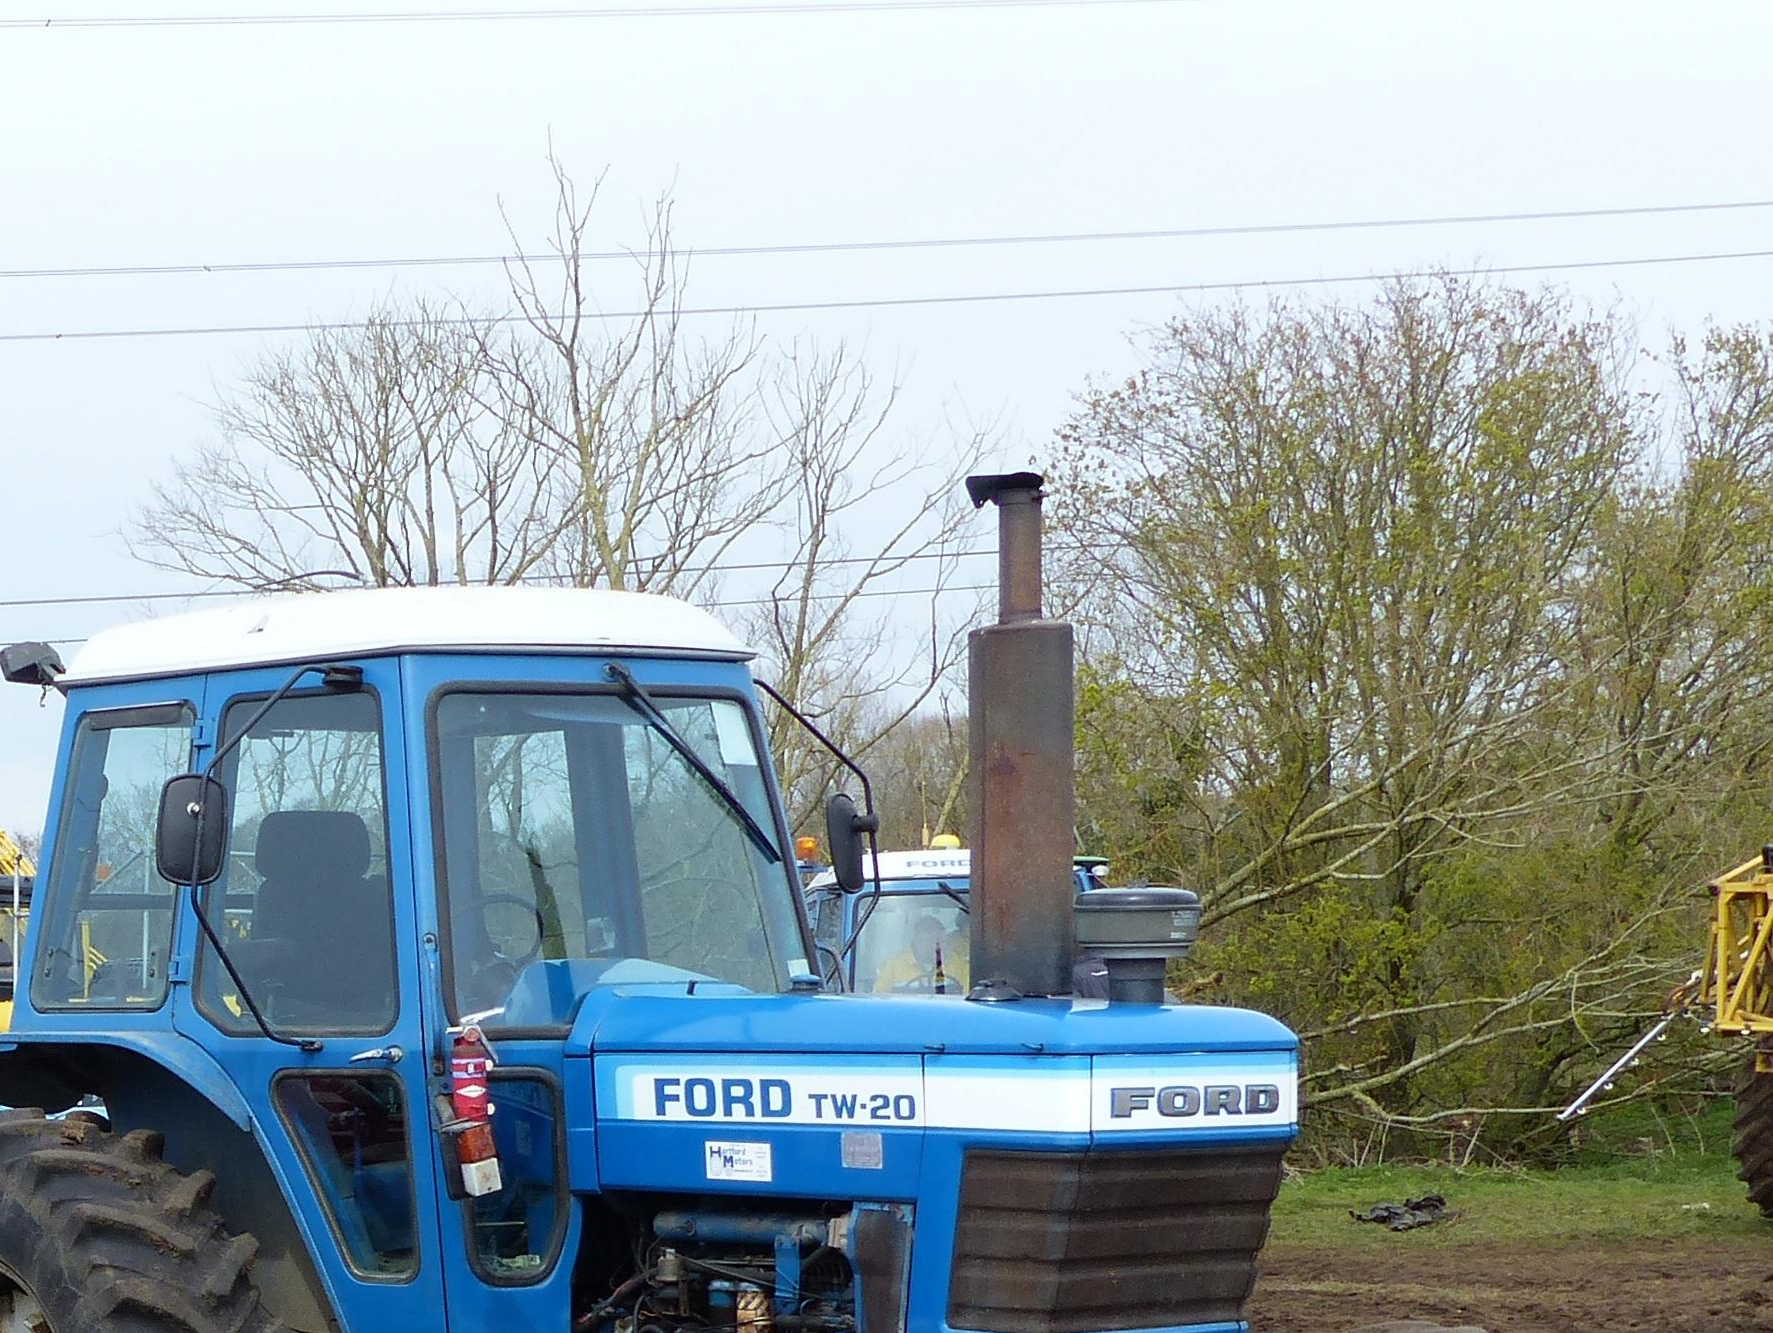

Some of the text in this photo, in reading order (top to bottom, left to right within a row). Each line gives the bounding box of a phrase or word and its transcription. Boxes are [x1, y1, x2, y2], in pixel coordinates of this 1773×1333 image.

[654, 1078, 916, 1120] FORD TW-20
[1110, 1084, 1279, 1118] FORD
